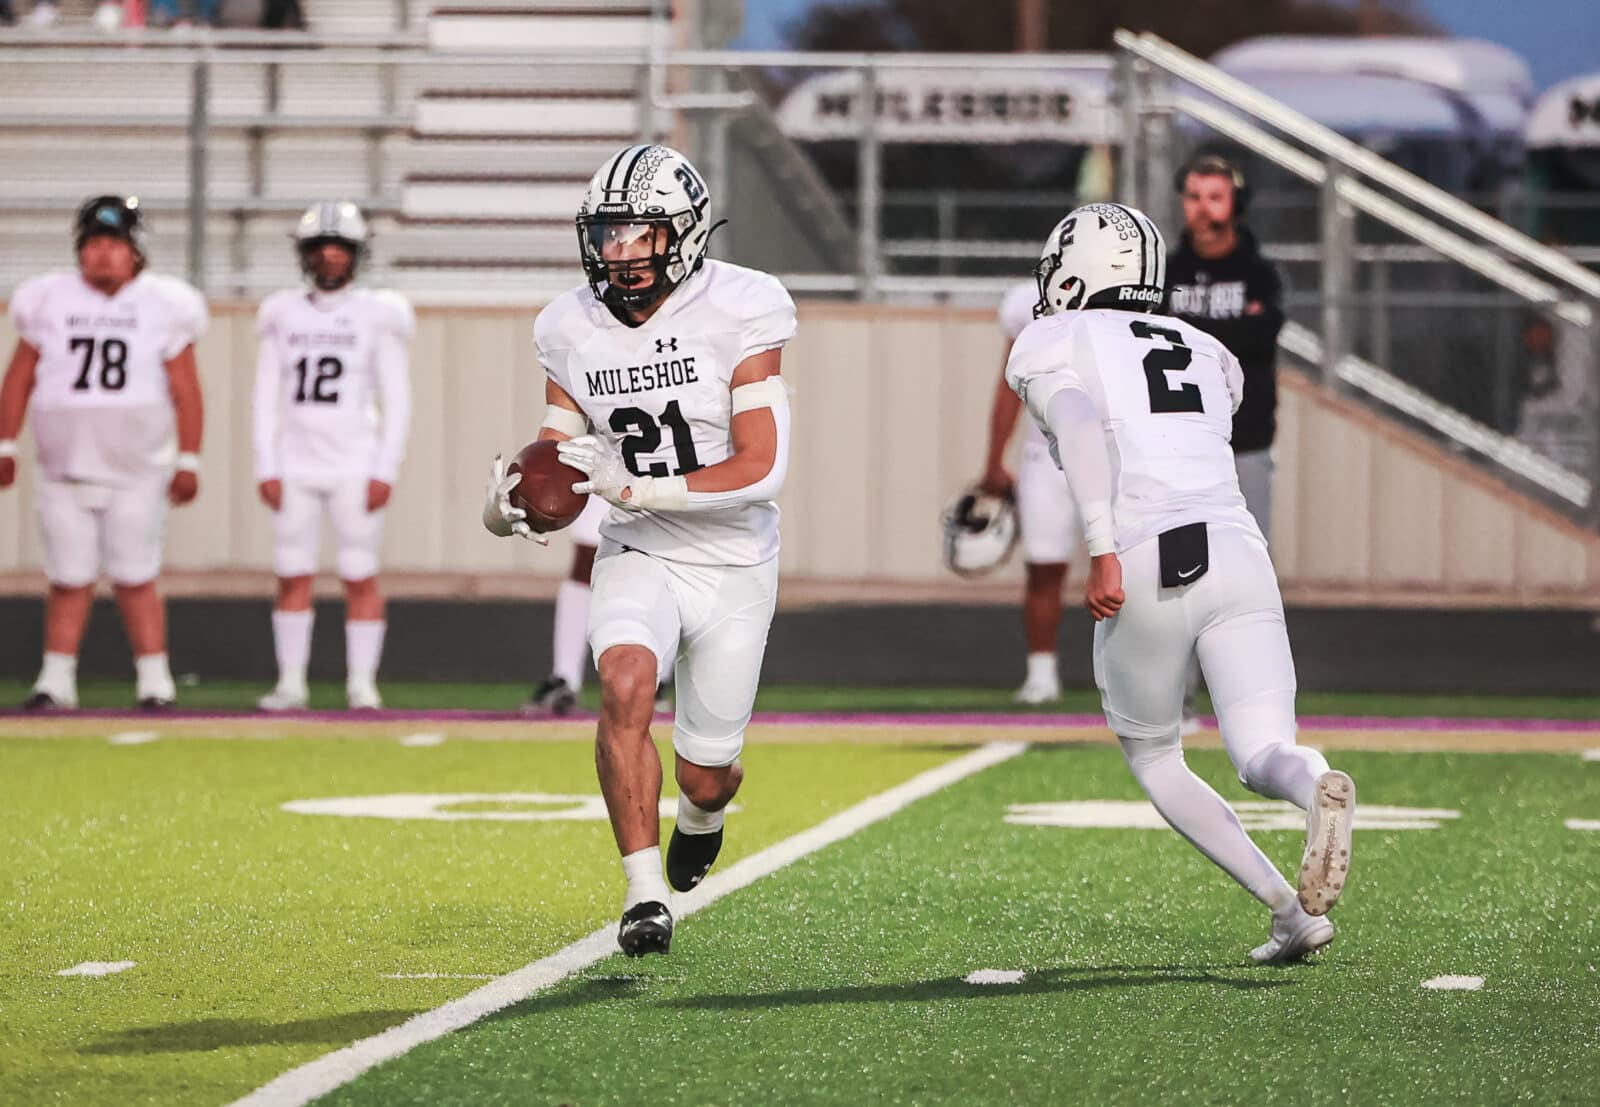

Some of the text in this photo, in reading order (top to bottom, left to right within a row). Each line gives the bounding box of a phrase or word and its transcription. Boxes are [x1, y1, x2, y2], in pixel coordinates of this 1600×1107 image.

[674, 162, 704, 202] 21
[1060, 217, 1078, 248] 2
[69, 337, 128, 391] 78
[294, 356, 343, 404] 12
[585, 357, 699, 397] MULESHOE
[1129, 320, 1205, 413] 2
[608, 399, 706, 478] 21
